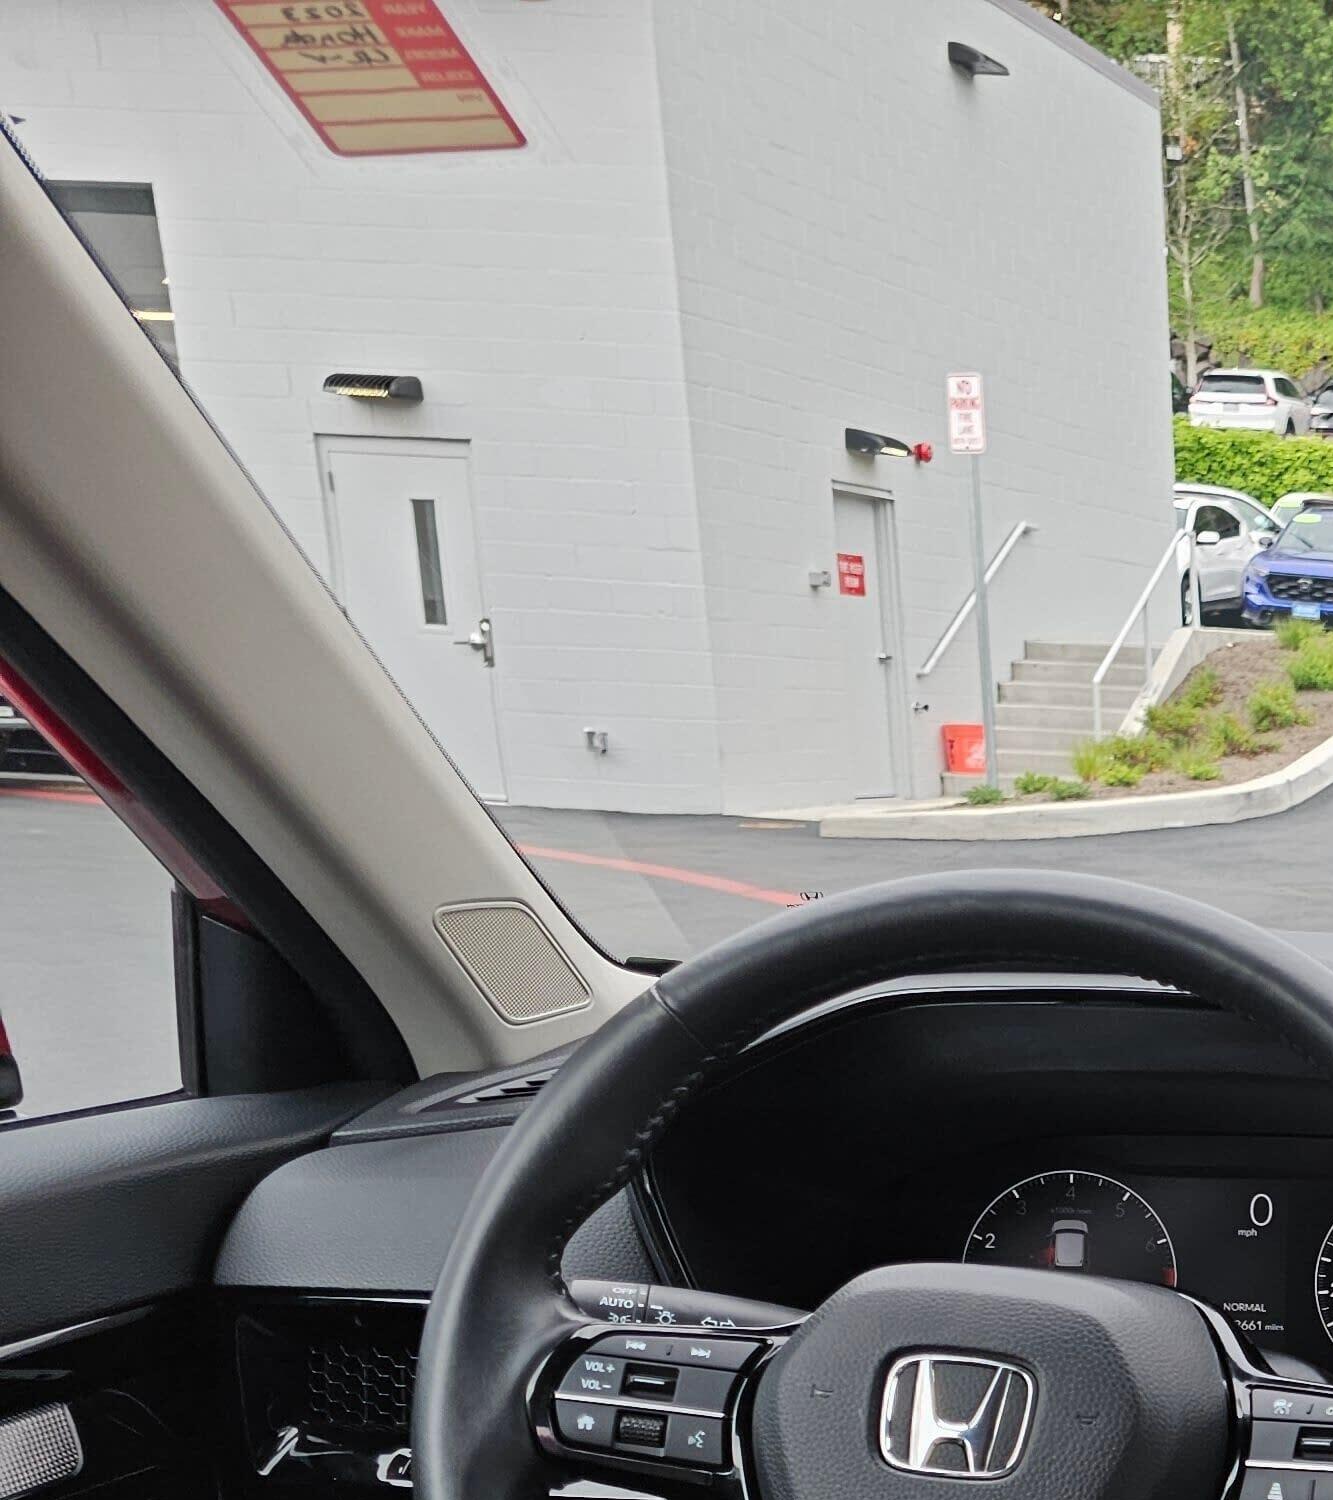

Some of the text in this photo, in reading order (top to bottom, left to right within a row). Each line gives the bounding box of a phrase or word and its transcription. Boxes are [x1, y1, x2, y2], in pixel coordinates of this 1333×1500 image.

[1066, 1186, 1076, 1200] 4
[1249, 1193, 1273, 1226] 0
[1237, 1228, 1258, 1238] mph
[985, 1233, 997, 1248] 2
[599, 1297, 634, 1309] AUTO
[1223, 1302, 1267, 1313] NORMAL
[1264, 1323, 1284, 1332] miles
